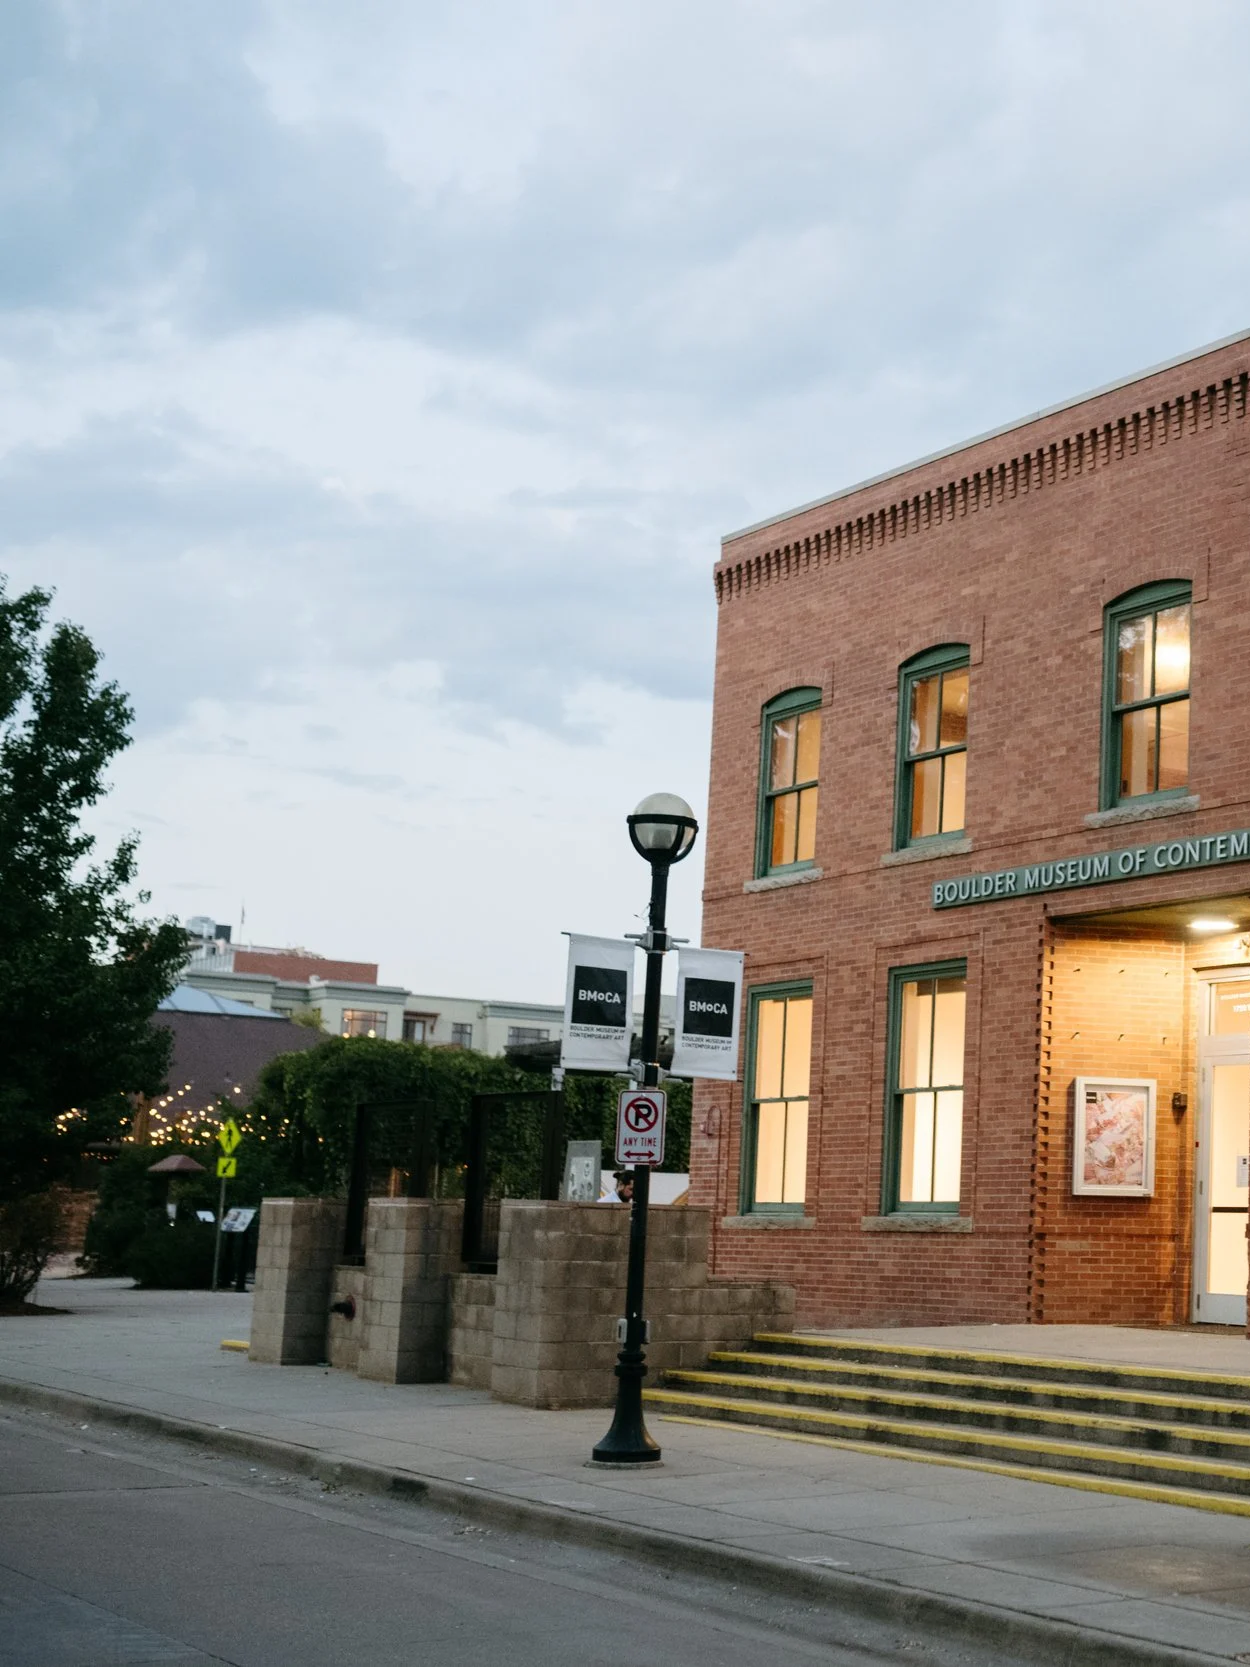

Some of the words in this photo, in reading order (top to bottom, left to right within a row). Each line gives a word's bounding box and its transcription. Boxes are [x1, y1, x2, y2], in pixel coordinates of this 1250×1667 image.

[933, 872, 1017, 905] BOULDER
[1024, 856, 1110, 889] MUSEUM
[1118, 849, 1146, 874] OF
[569, 1032, 613, 1040] CONTEMPORARY
[682, 1042, 720, 1050] CONTEMPORARY
[623, 1137, 638, 1146] ANY
[641, 1137, 657, 1147] TIME
